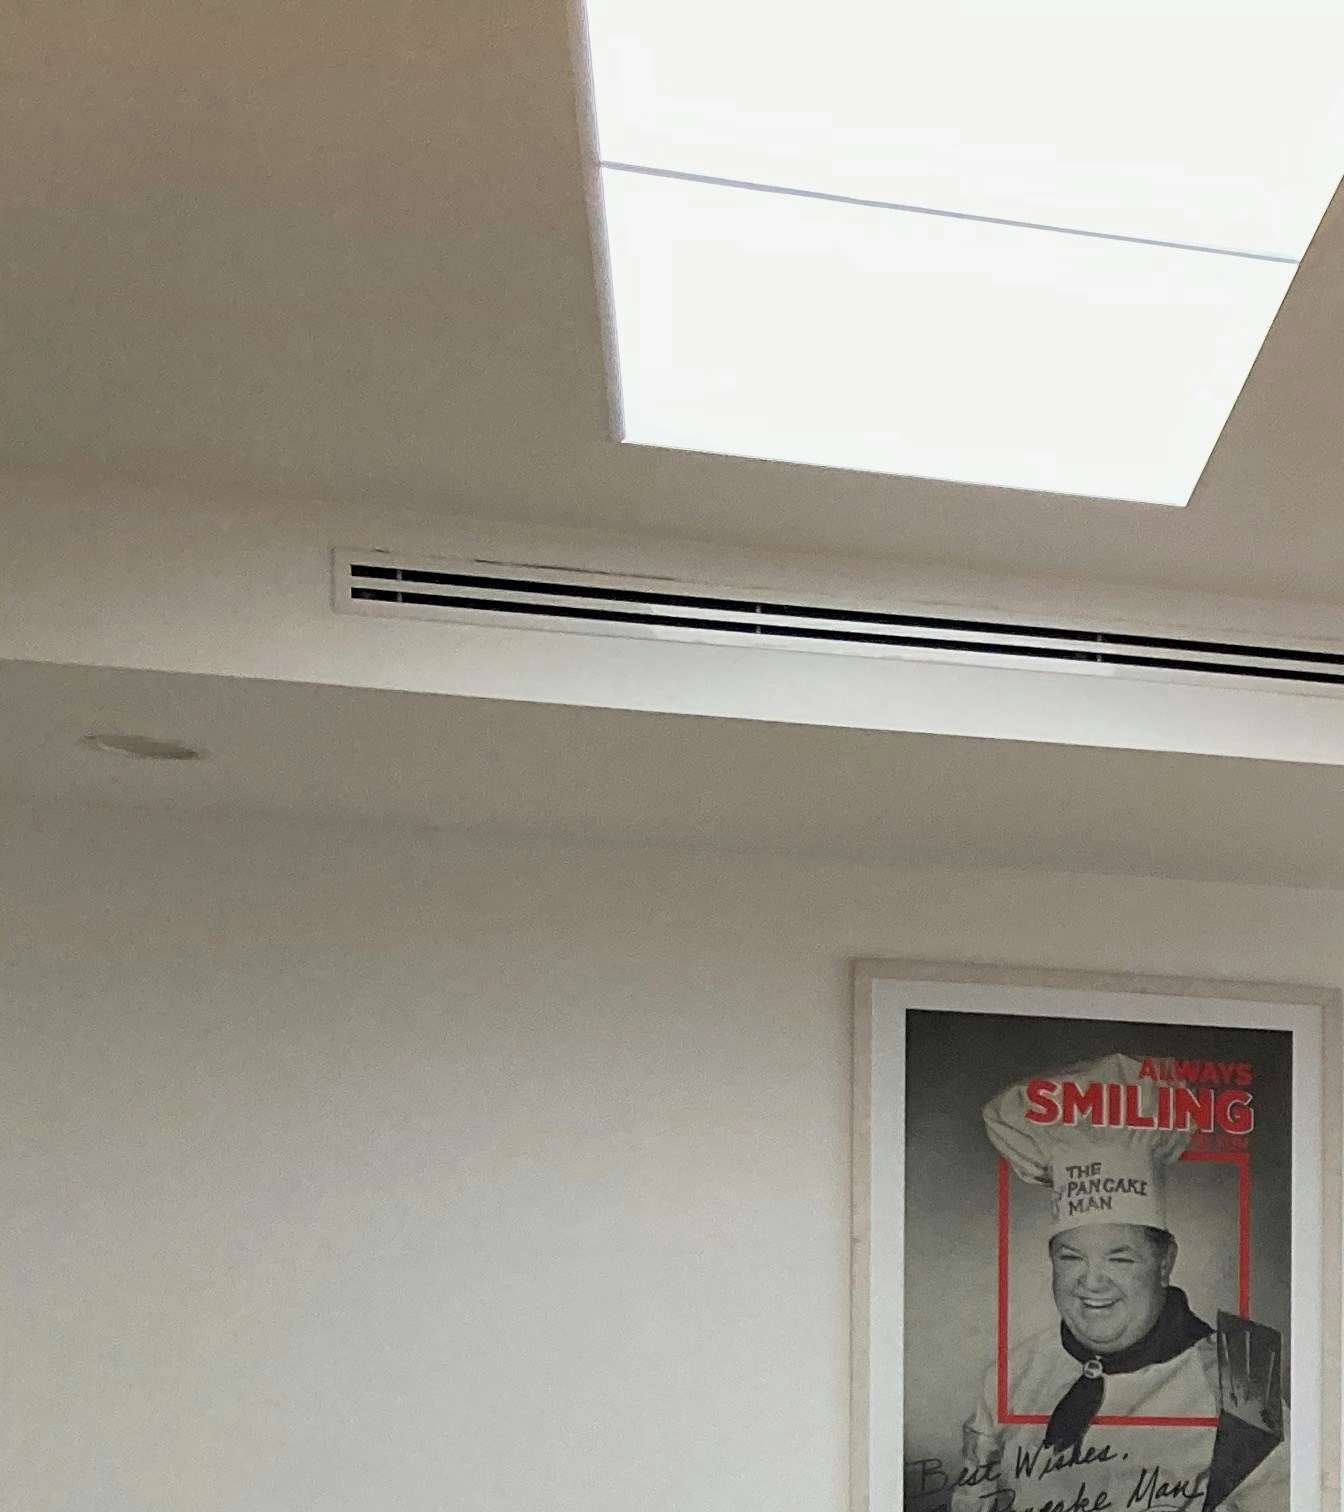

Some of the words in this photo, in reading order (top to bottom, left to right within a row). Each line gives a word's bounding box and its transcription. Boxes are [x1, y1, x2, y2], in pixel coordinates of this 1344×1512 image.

[1138, 1058, 1252, 1085] ALWAYS
[1025, 1078, 1254, 1135] SMILING
[1065, 1162, 1102, 1179] THE
[1067, 1177, 1148, 1199] PANCAKE
[1067, 1196, 1113, 1215] MAN
